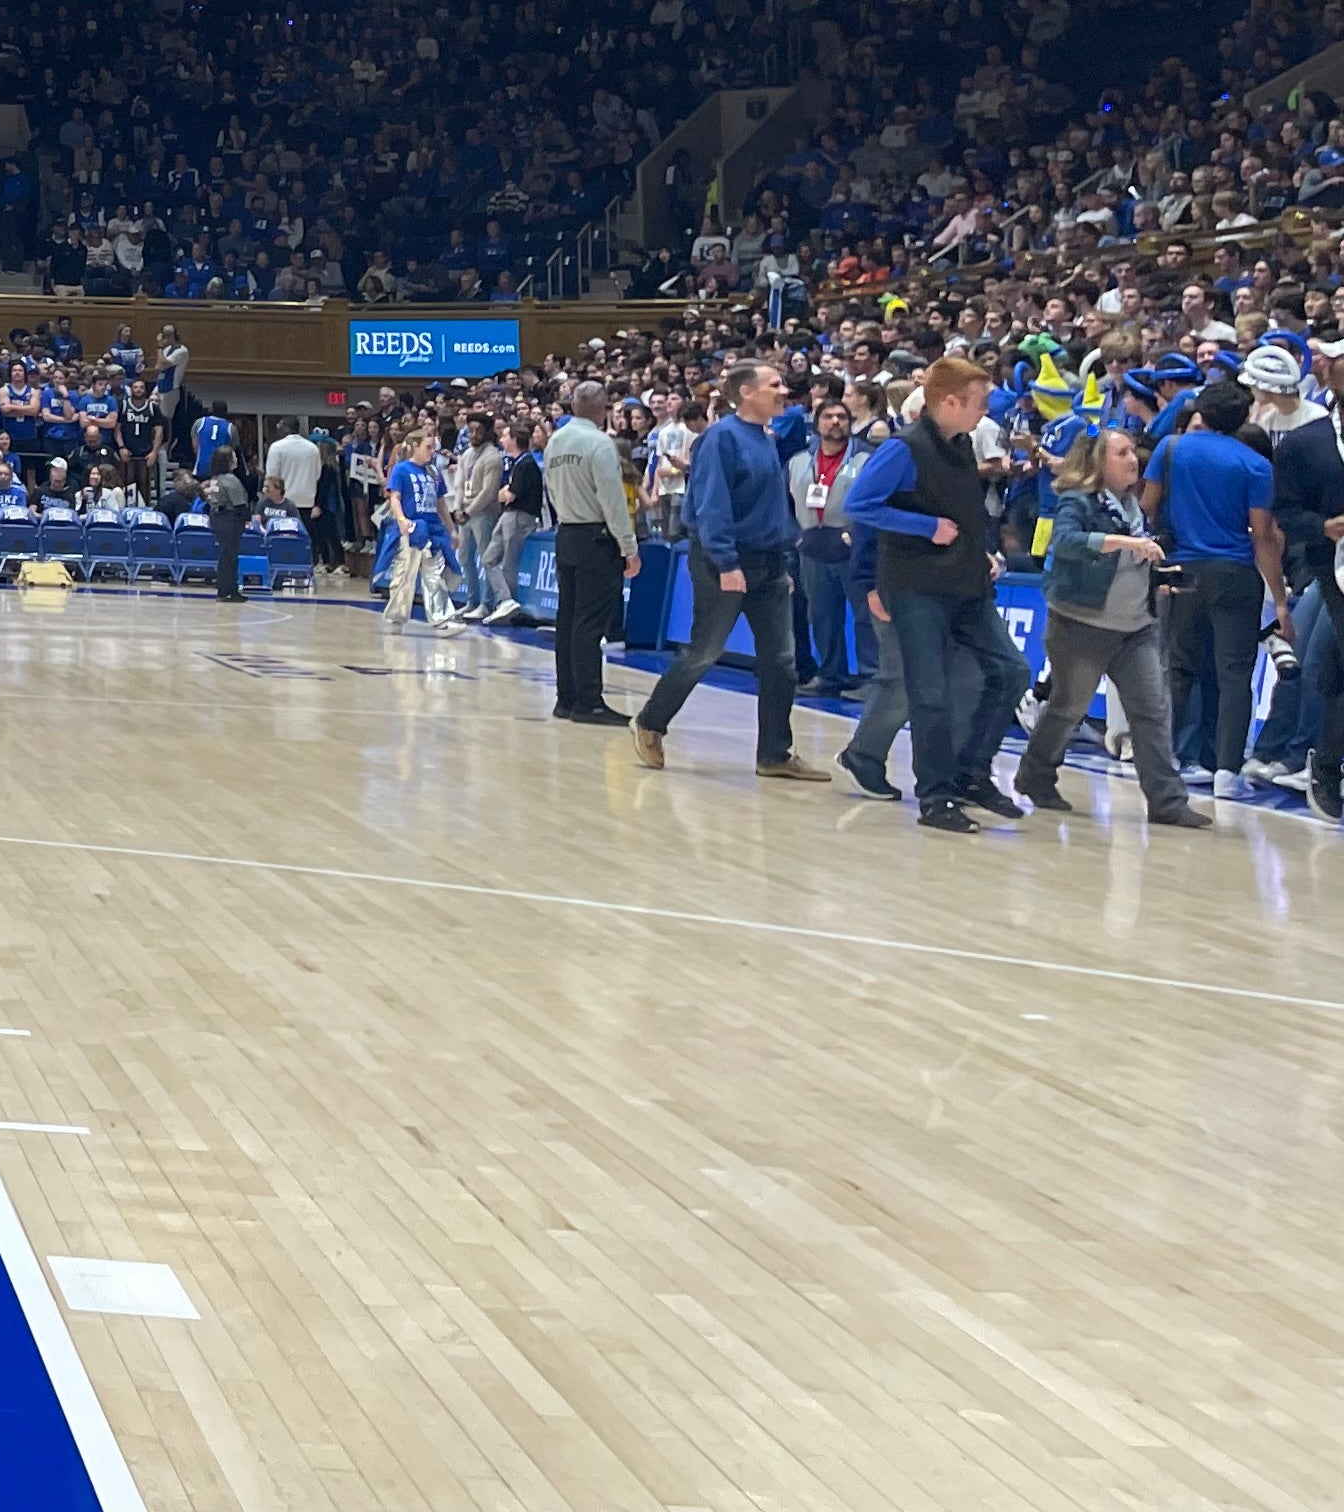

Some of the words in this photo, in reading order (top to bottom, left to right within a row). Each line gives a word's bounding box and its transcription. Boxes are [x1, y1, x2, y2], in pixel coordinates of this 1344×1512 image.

[355, 332, 433, 355] REEDS
[453, 342, 516, 354] REEDS.com
[126, 411, 150, 424] Duke
[134, 424, 140, 436] 1
[211, 424, 219, 440] 1
[263, 506, 287, 517] DUKE
